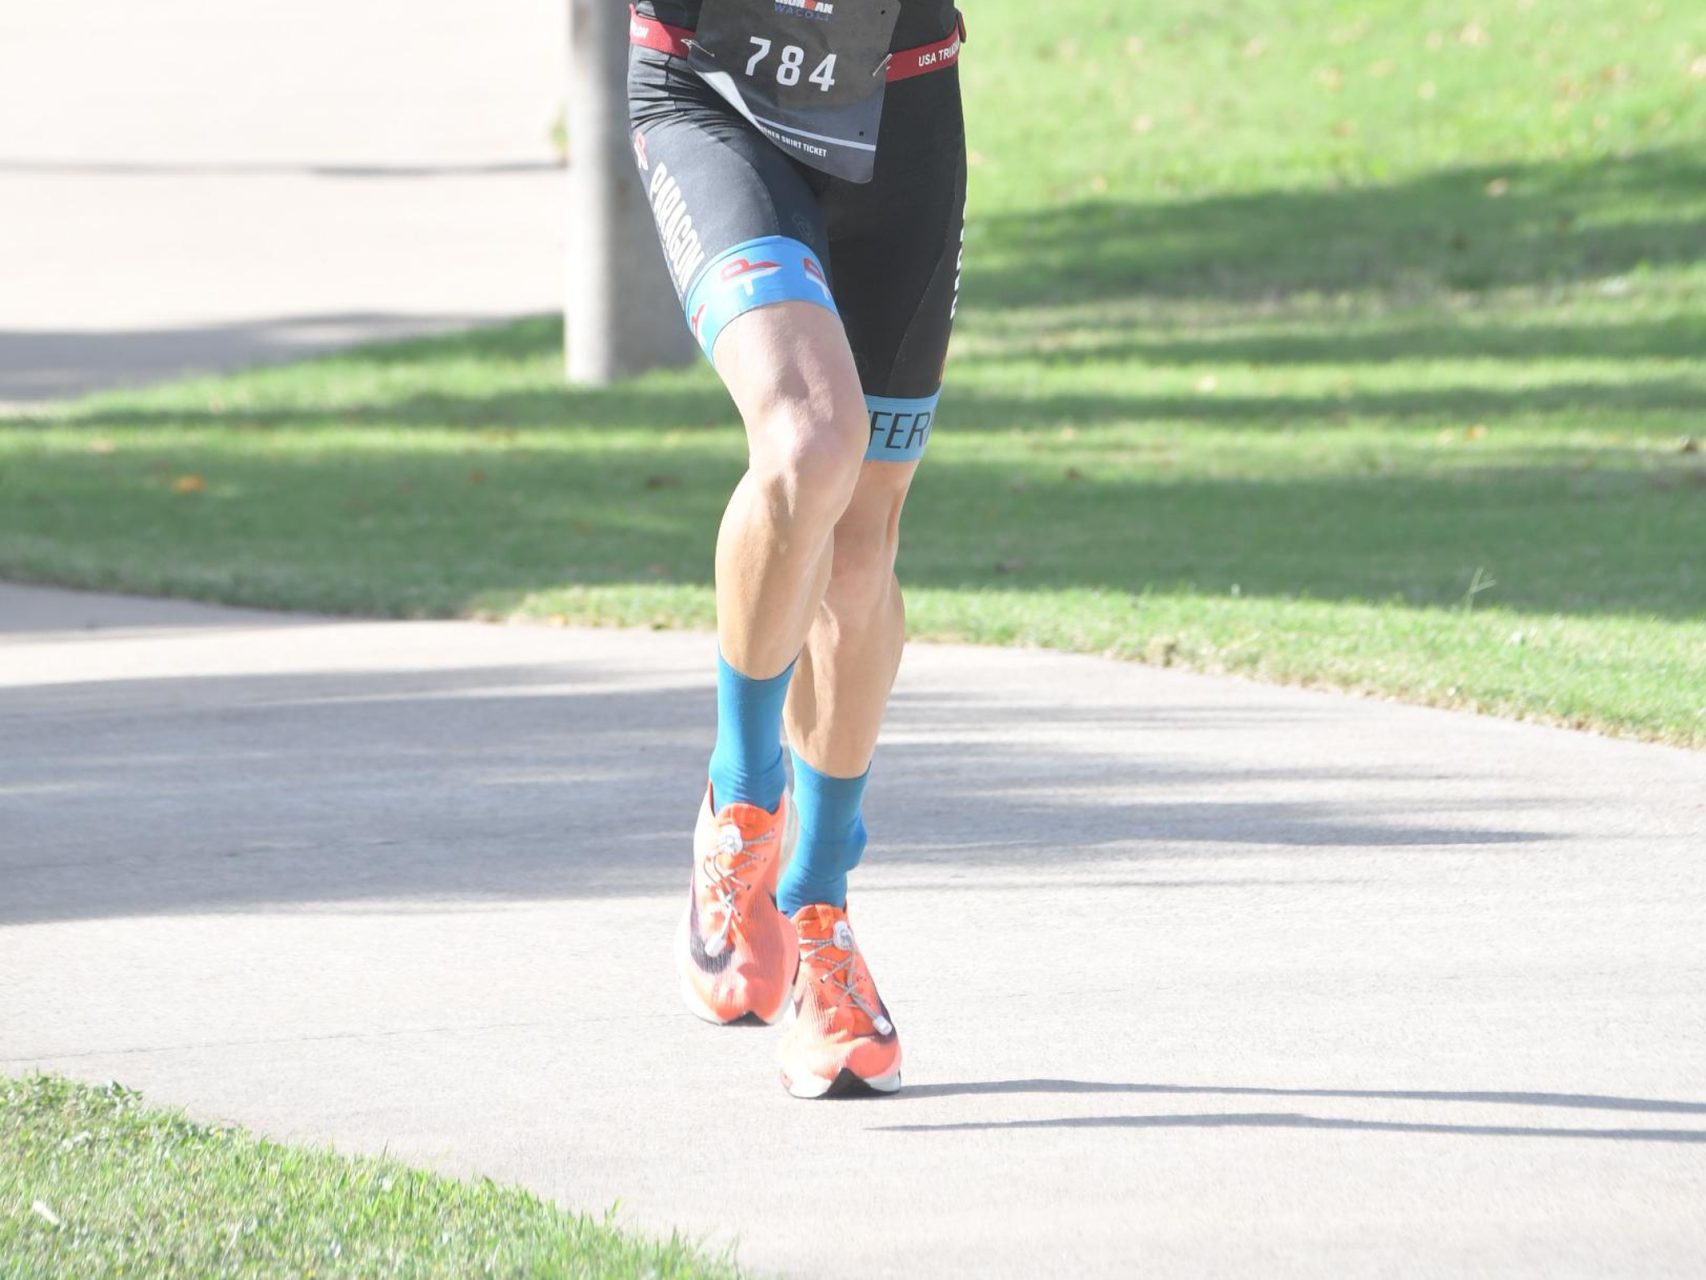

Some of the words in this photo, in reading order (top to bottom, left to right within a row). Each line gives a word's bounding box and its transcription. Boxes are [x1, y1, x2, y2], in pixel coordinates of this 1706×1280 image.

[745, 35, 837, 93] 784
[918, 52, 937, 67] USA
[780, 135, 802, 150] SHIRT
[802, 143, 828, 157] TICKET
